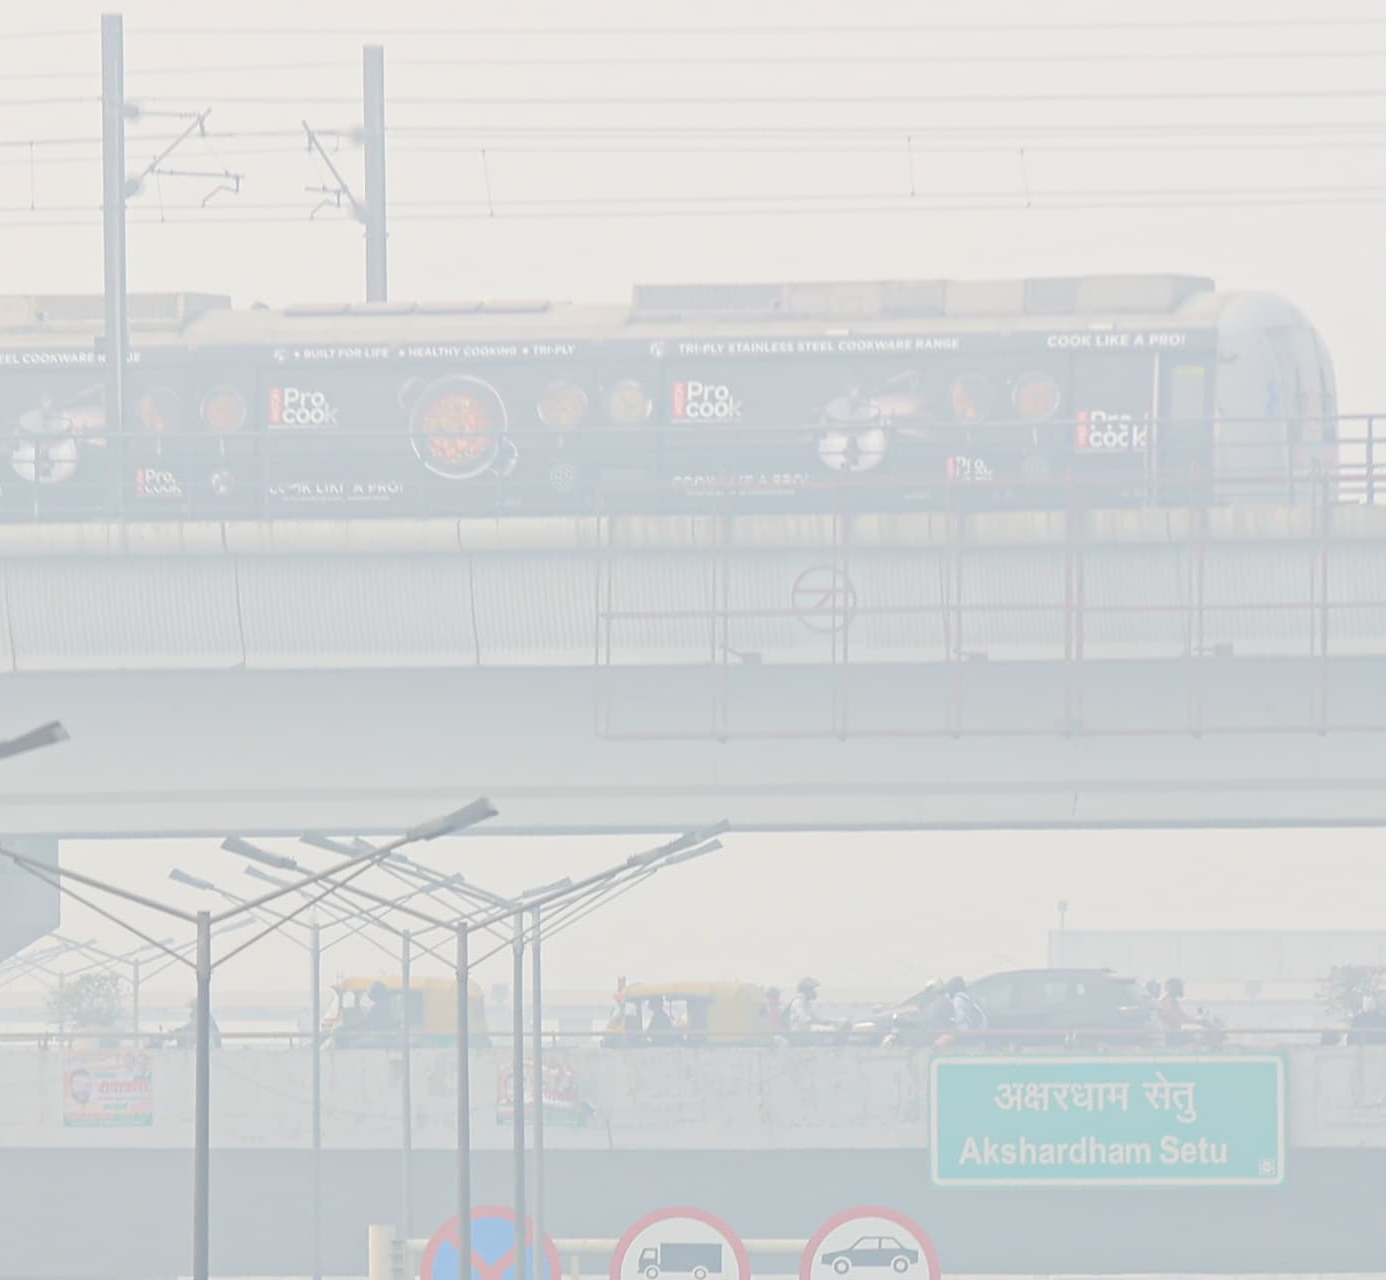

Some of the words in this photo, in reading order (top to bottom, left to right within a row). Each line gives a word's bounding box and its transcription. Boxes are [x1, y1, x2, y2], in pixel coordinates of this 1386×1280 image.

[678, 343, 725, 354] TRI-PLY
[728, 342, 792, 353] STAINLESS
[795, 341, 833, 352] STEEL
[837, 340, 912, 351] COOKWARE
[915, 338, 959, 350] RANGE
[1046, 335, 1091, 347] COOK
[1095, 335, 1127, 347] LIKE
[1133, 334, 1145, 346] A
[1148, 333, 1186, 346] PRO!
[22, 352, 95, 364] COOKWARE
[303, 349, 335, 360] BUILT
[337, 348, 356, 359] FOR
[358, 347, 389, 358] LIFE
[409, 347, 460, 358] HEALTHY
[463, 346, 517, 357] COOKING
[532, 345, 575, 356] TRI-PLY
[283, 387, 325, 407] Pro
[686, 381, 731, 401] Pro
[282, 402, 340, 424] cook
[685, 395, 742, 418] cook
[994, 1080, 1130, 1112] अक्षरधाम
[1142, 1071, 1198, 1125] सेतु
[958, 1136, 1152, 1166] Akshardham
[1159, 1135, 1229, 1165] Setu
